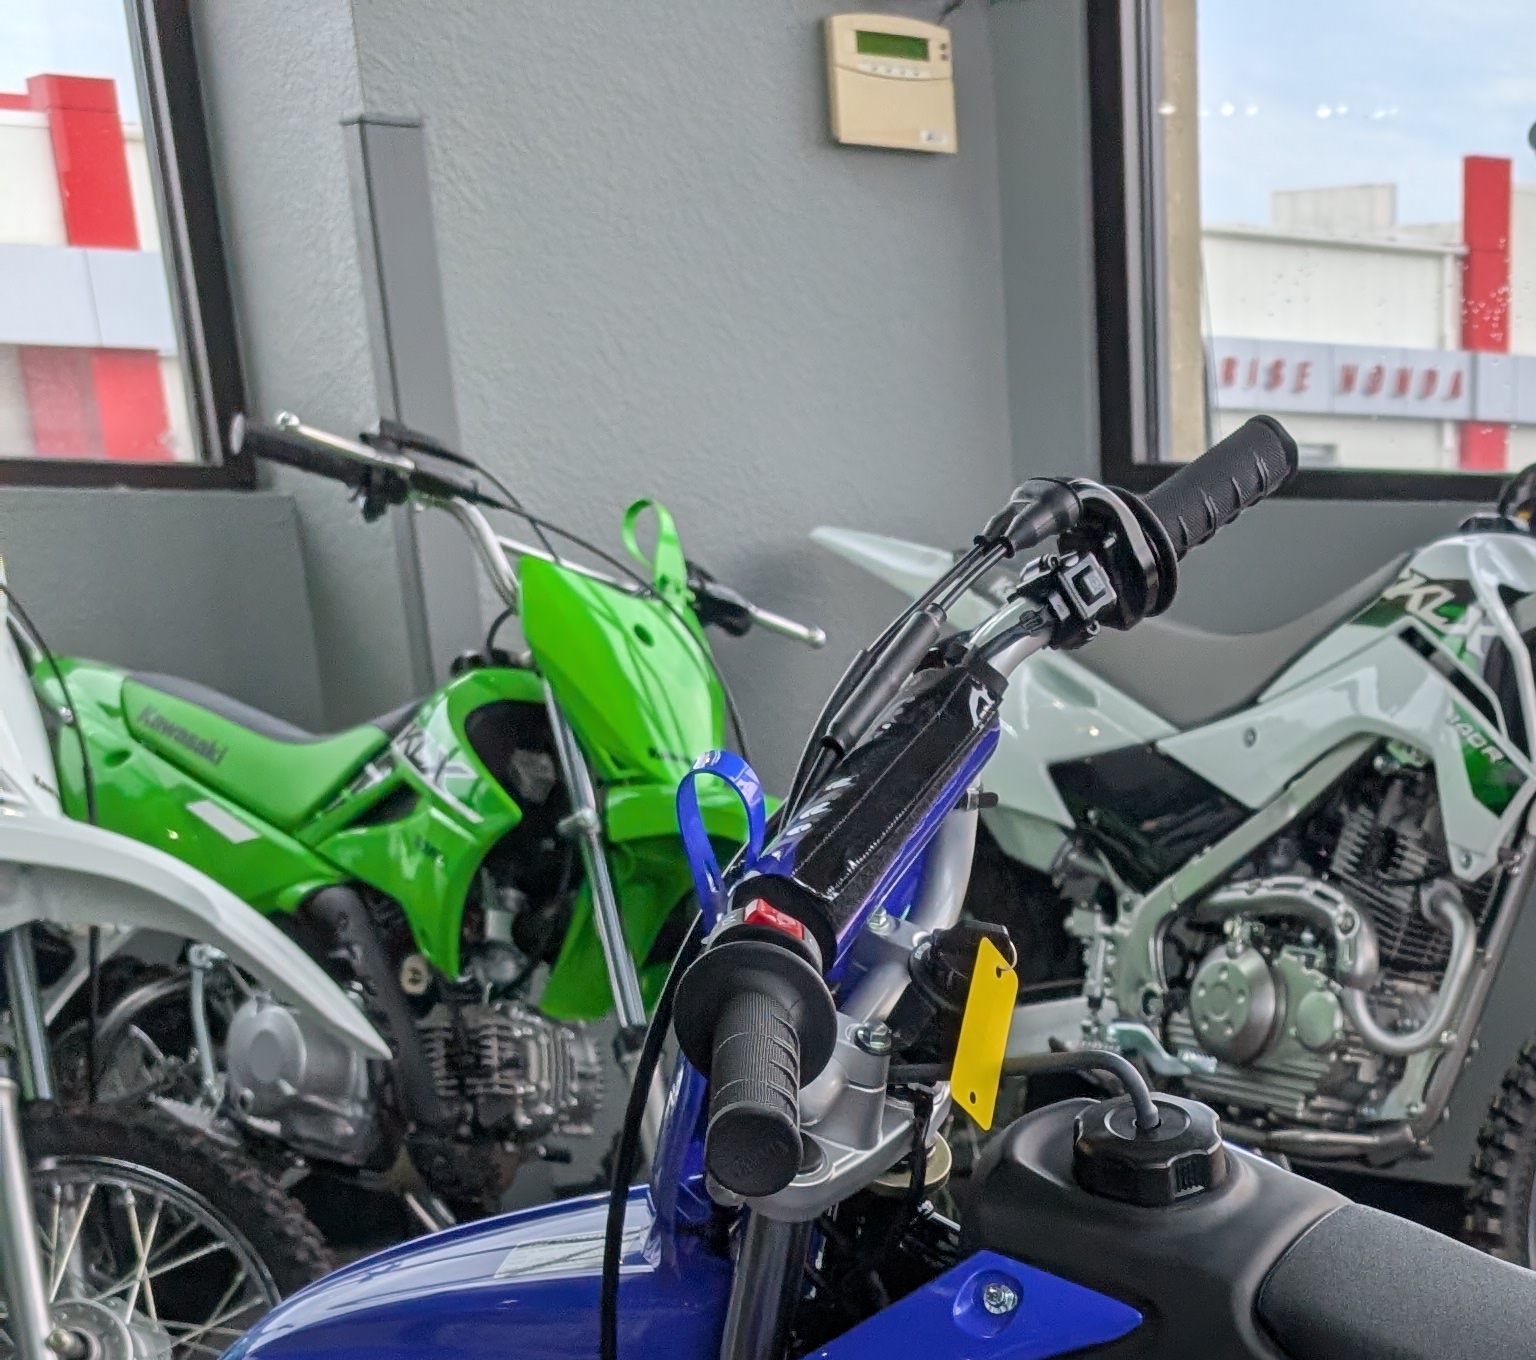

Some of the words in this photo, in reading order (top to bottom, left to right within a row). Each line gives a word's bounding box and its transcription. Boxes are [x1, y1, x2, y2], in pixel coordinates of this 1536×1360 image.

[1219, 355, 1313, 393] RISE
[1338, 361, 1465, 400] HONDA
[137, 703, 230, 766] Kawasaki
